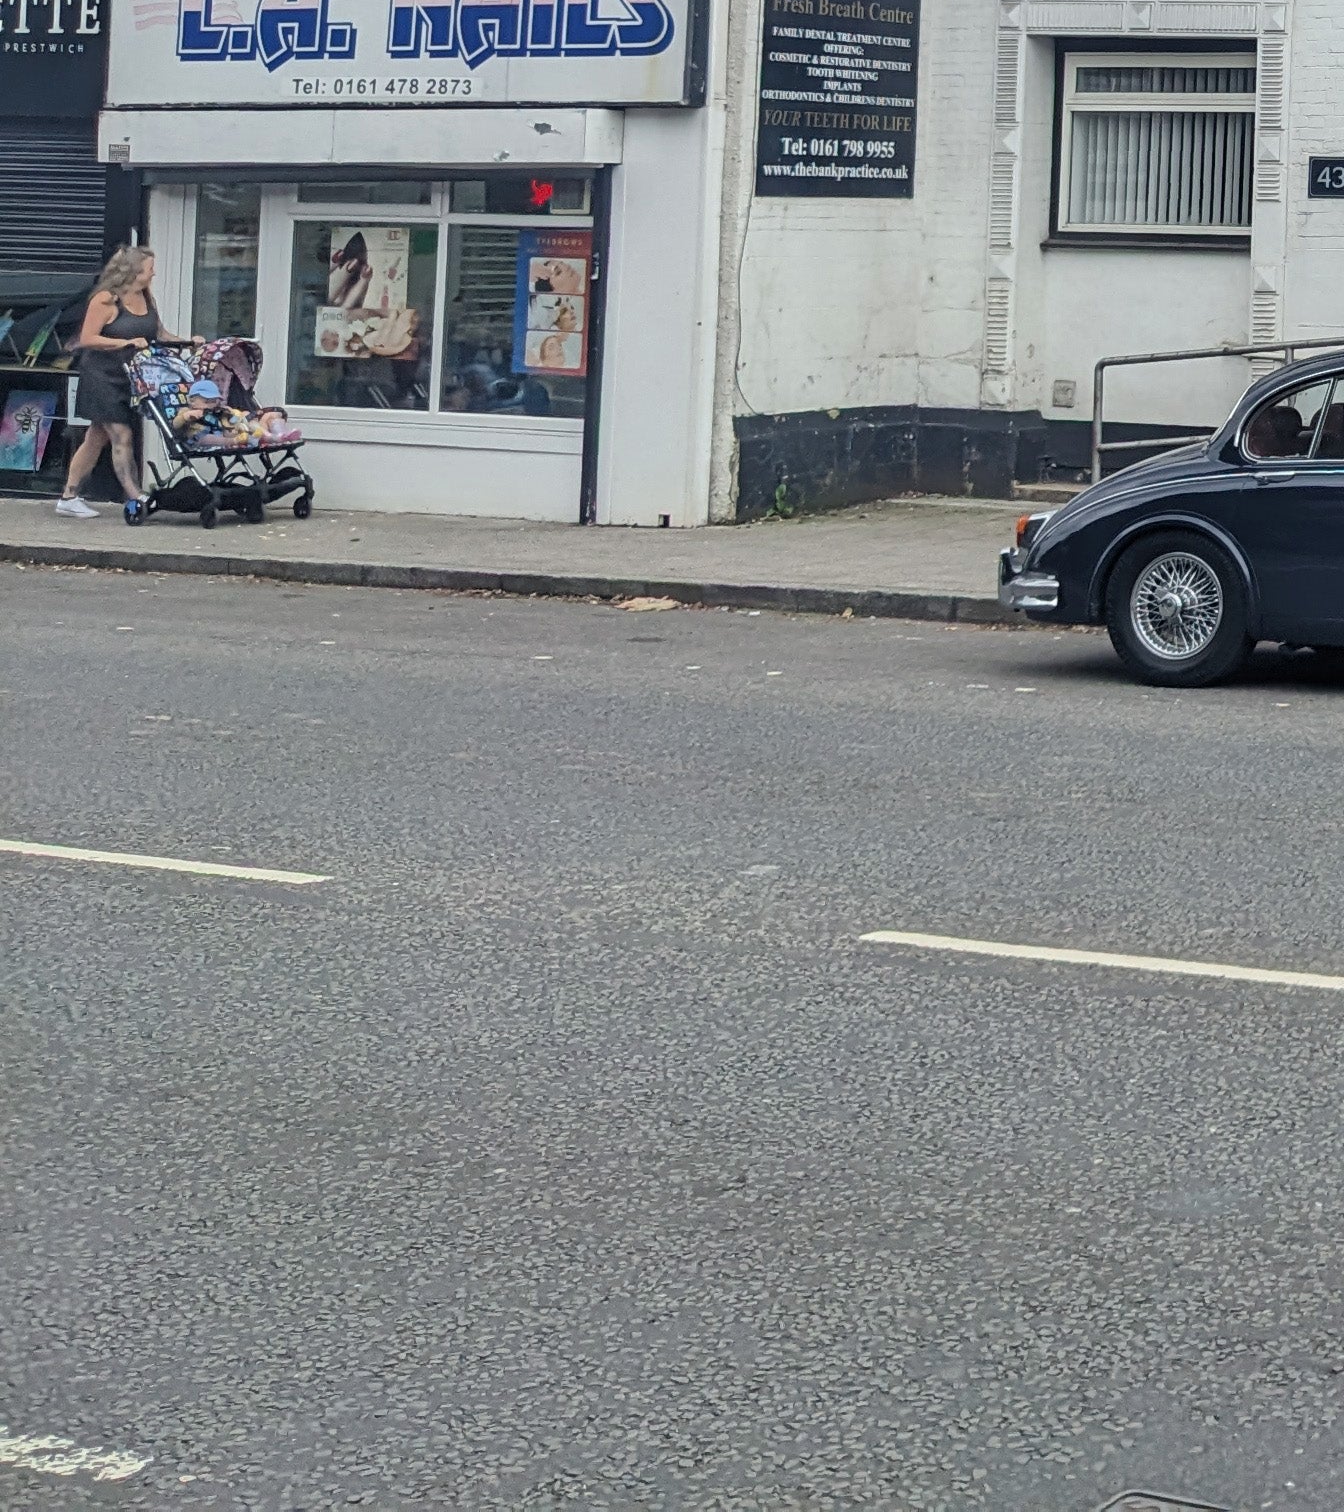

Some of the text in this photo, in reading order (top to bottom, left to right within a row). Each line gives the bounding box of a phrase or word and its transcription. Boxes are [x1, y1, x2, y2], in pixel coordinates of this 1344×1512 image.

[869, 3, 913, 24] Centre
[773, 27, 911, 47] FAMILY DENTAL TREATMENT CENTRE
[4, 43, 84, 53] PRESTWICH
[769, 52, 810, 63] COSMETIC
[820, 57, 872, 68] RESTORATIVE
[873, 61, 912, 71] DENTISTRY
[807, 67, 878, 81] TOOTH WHITENING
[292, 79, 472, 95] Tel: 0161 478 2873
[823, 81, 862, 91] IMPLANTS
[762, 90, 824, 102] ORTHODONTICS
[876, 97, 915, 108] DENTISTRY
[763, 109, 911, 132] YOUR TEETH FOR LIFE
[782, 137, 895, 158] Tel: 0161 798 9955
[763, 162, 908, 181] www.thebankpractice.co.uk
